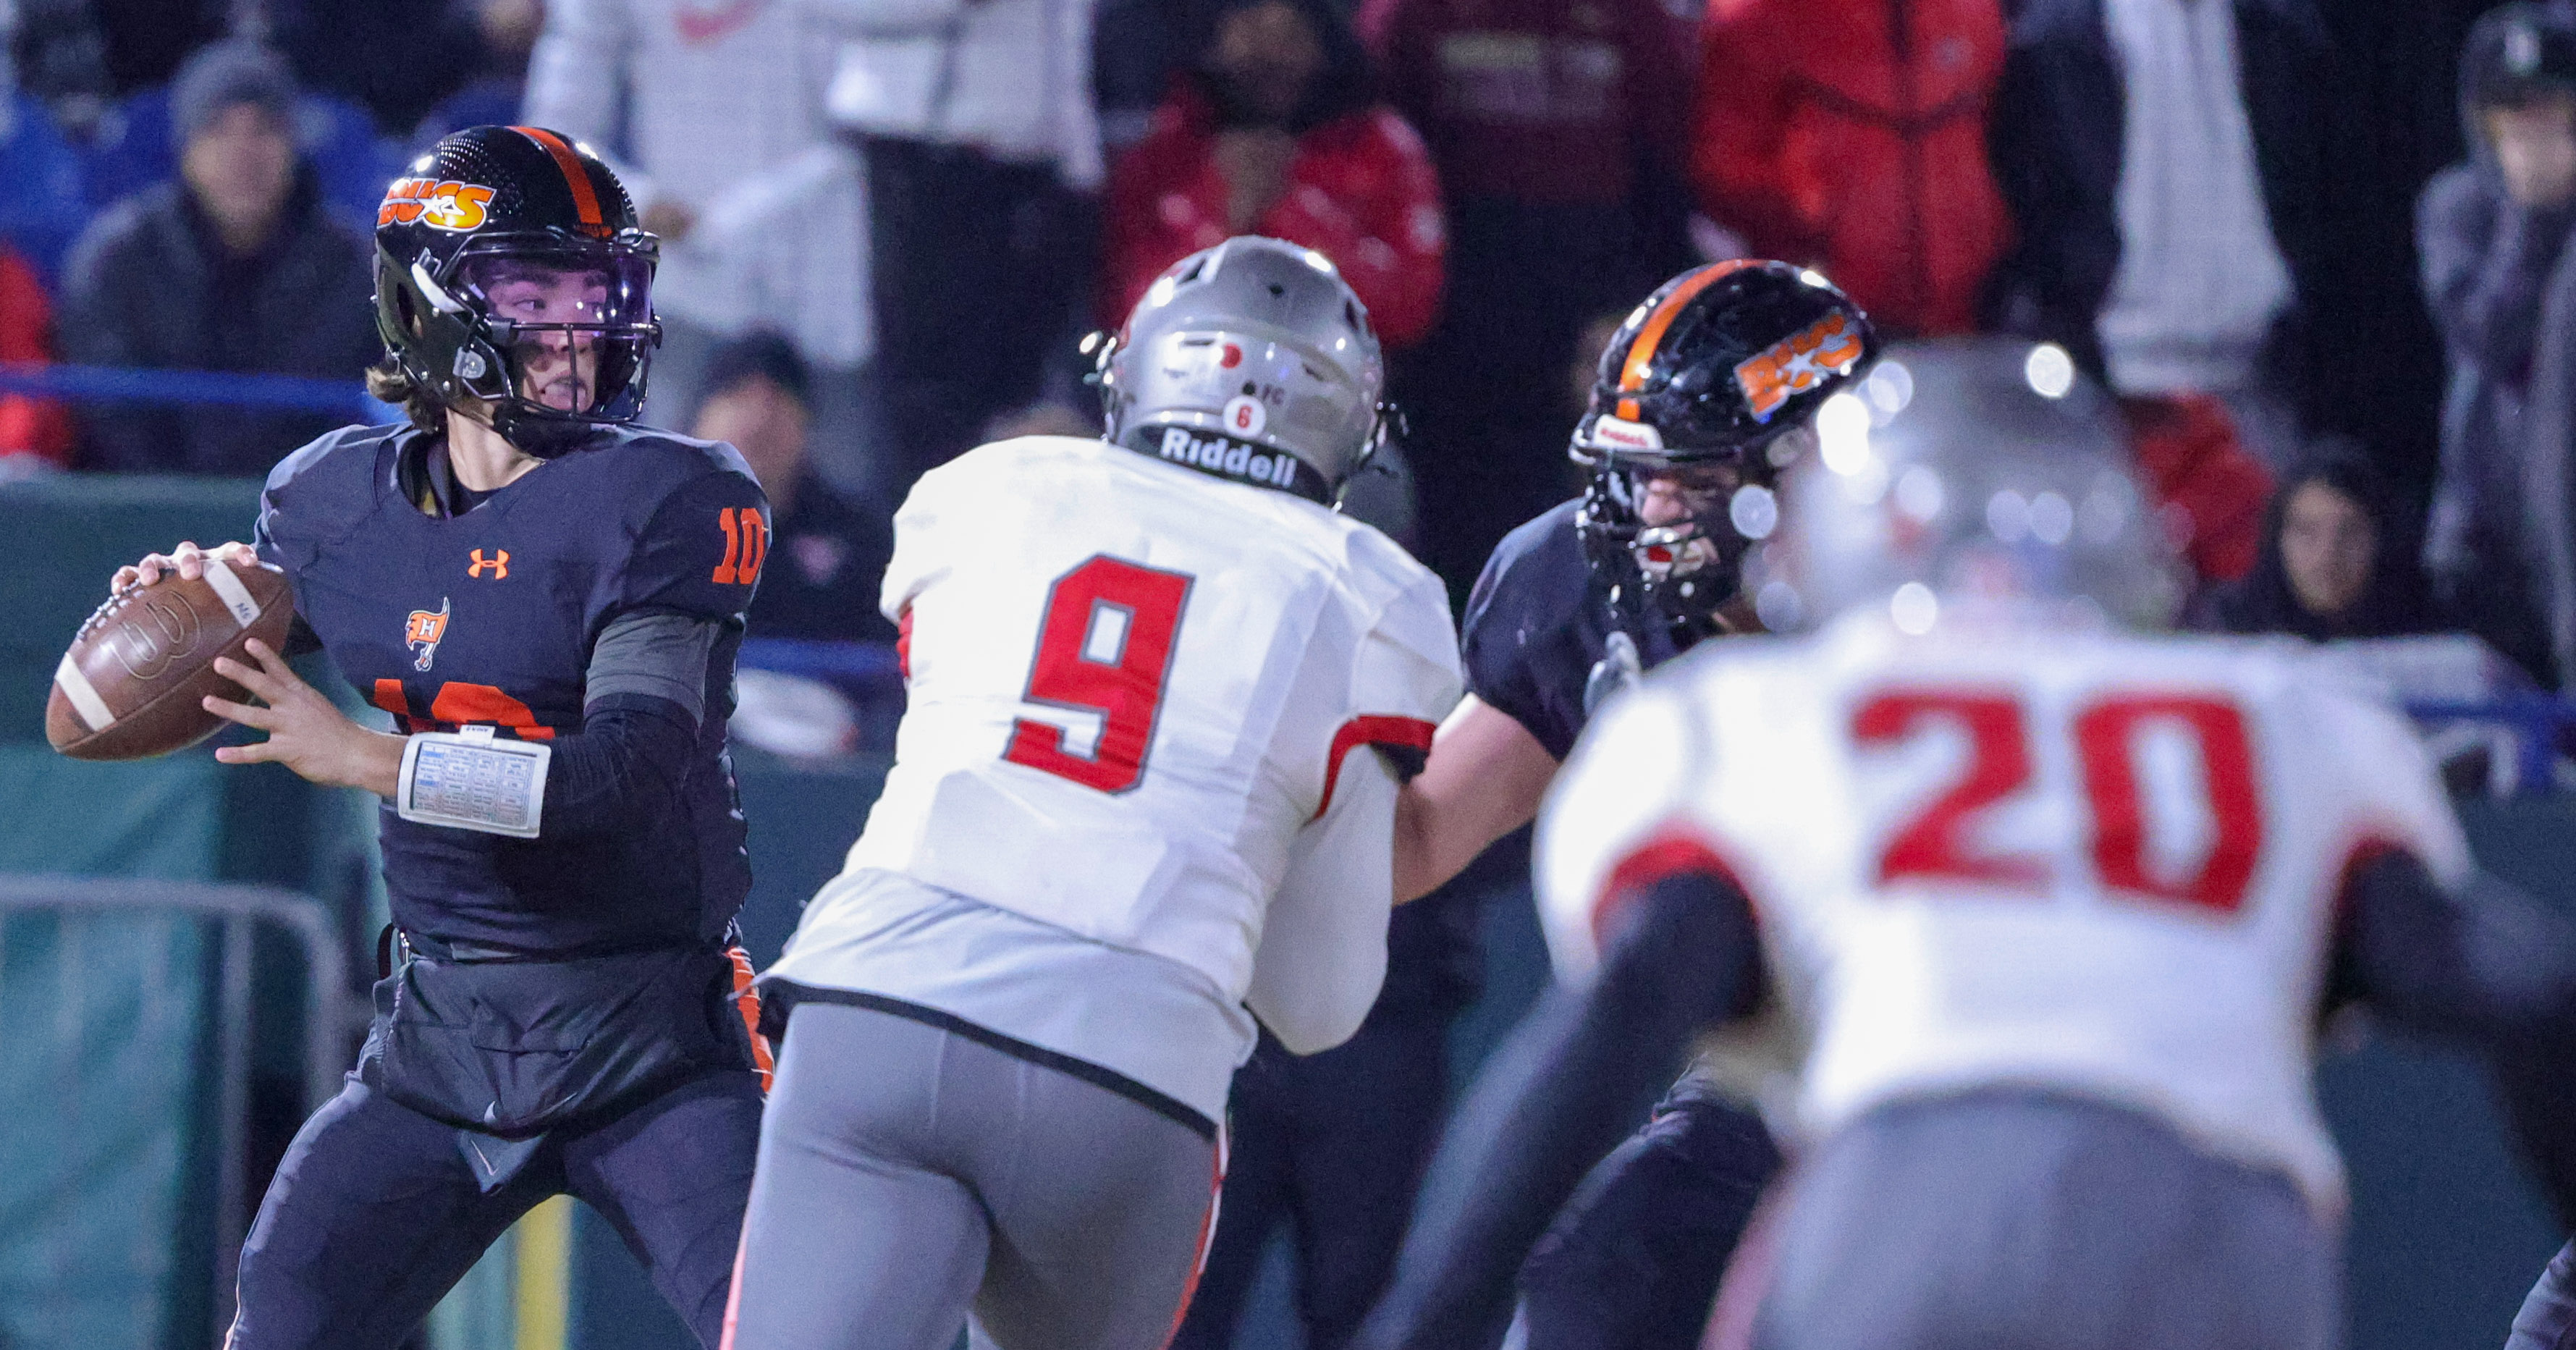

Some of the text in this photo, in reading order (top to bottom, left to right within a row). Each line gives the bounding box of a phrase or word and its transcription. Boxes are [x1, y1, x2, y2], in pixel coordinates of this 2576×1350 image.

[1237, 405, 1253, 429] 6
[1160, 426, 1297, 489] Riddell
[712, 507, 765, 585] 10
[418, 617, 437, 638] H
[1000, 552, 1196, 796] 9
[1849, 690, 2264, 914] 20
